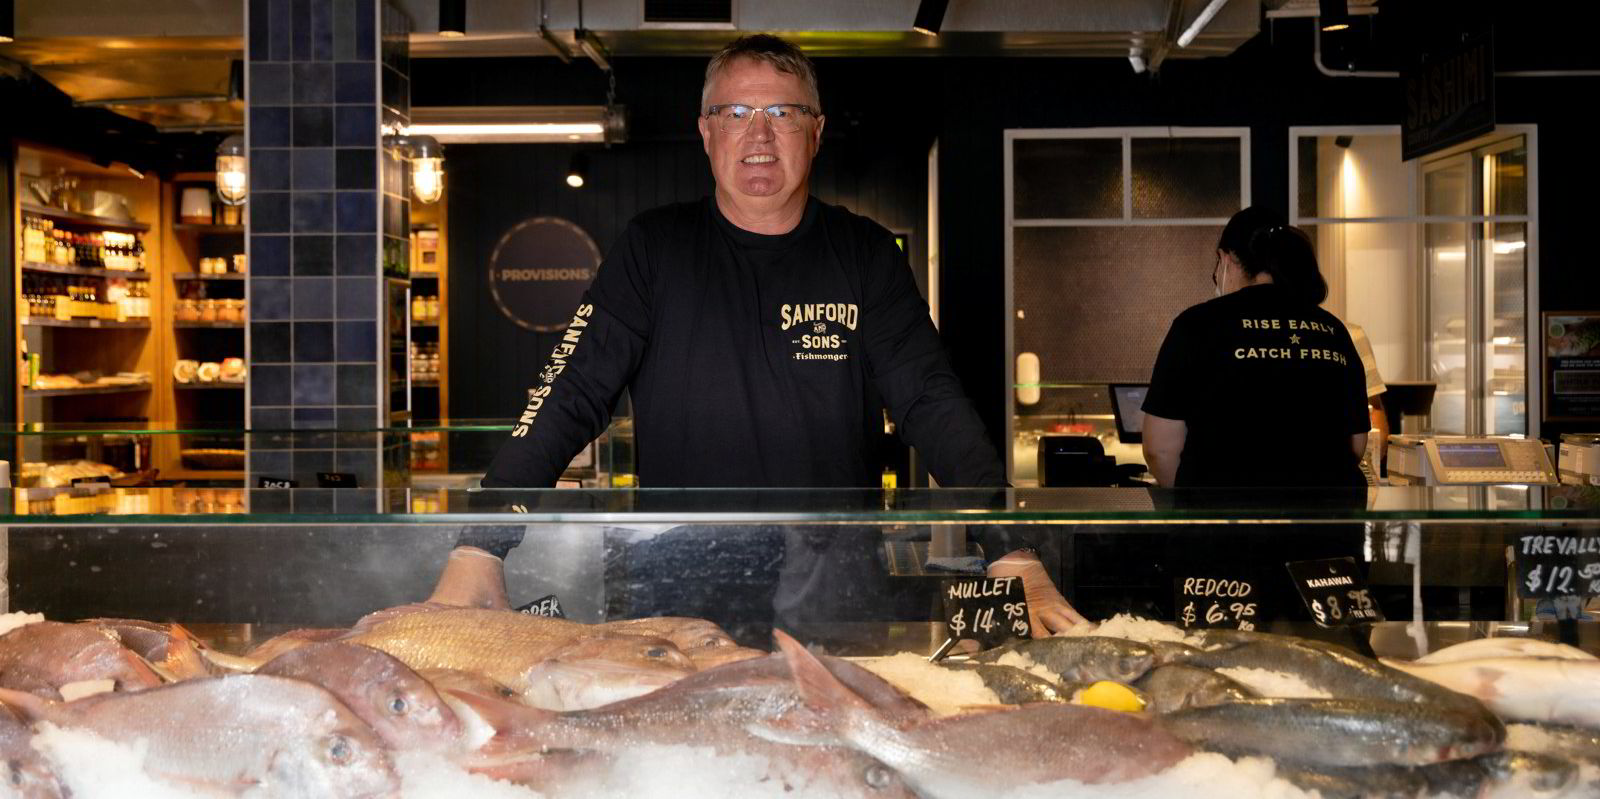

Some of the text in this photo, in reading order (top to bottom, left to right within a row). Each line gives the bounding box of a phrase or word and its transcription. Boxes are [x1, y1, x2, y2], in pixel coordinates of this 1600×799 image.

[1407, 44, 1486, 130] SASHIMI
[502, 268, 590, 281] PROVISIONS
[781, 303, 858, 331] SANFORD
[1242, 319, 1335, 335] RISE EARLY
[802, 334, 840, 349] SONS
[796, 352, 848, 362] Fishmonger
[1234, 347, 1347, 366] CATCH FRESH
[512, 386, 552, 437] SONS
[948, 576, 1017, 600] MULLET
[1183, 577, 1252, 597] REDCOD
[1306, 575, 1353, 588] KAHAWAI
